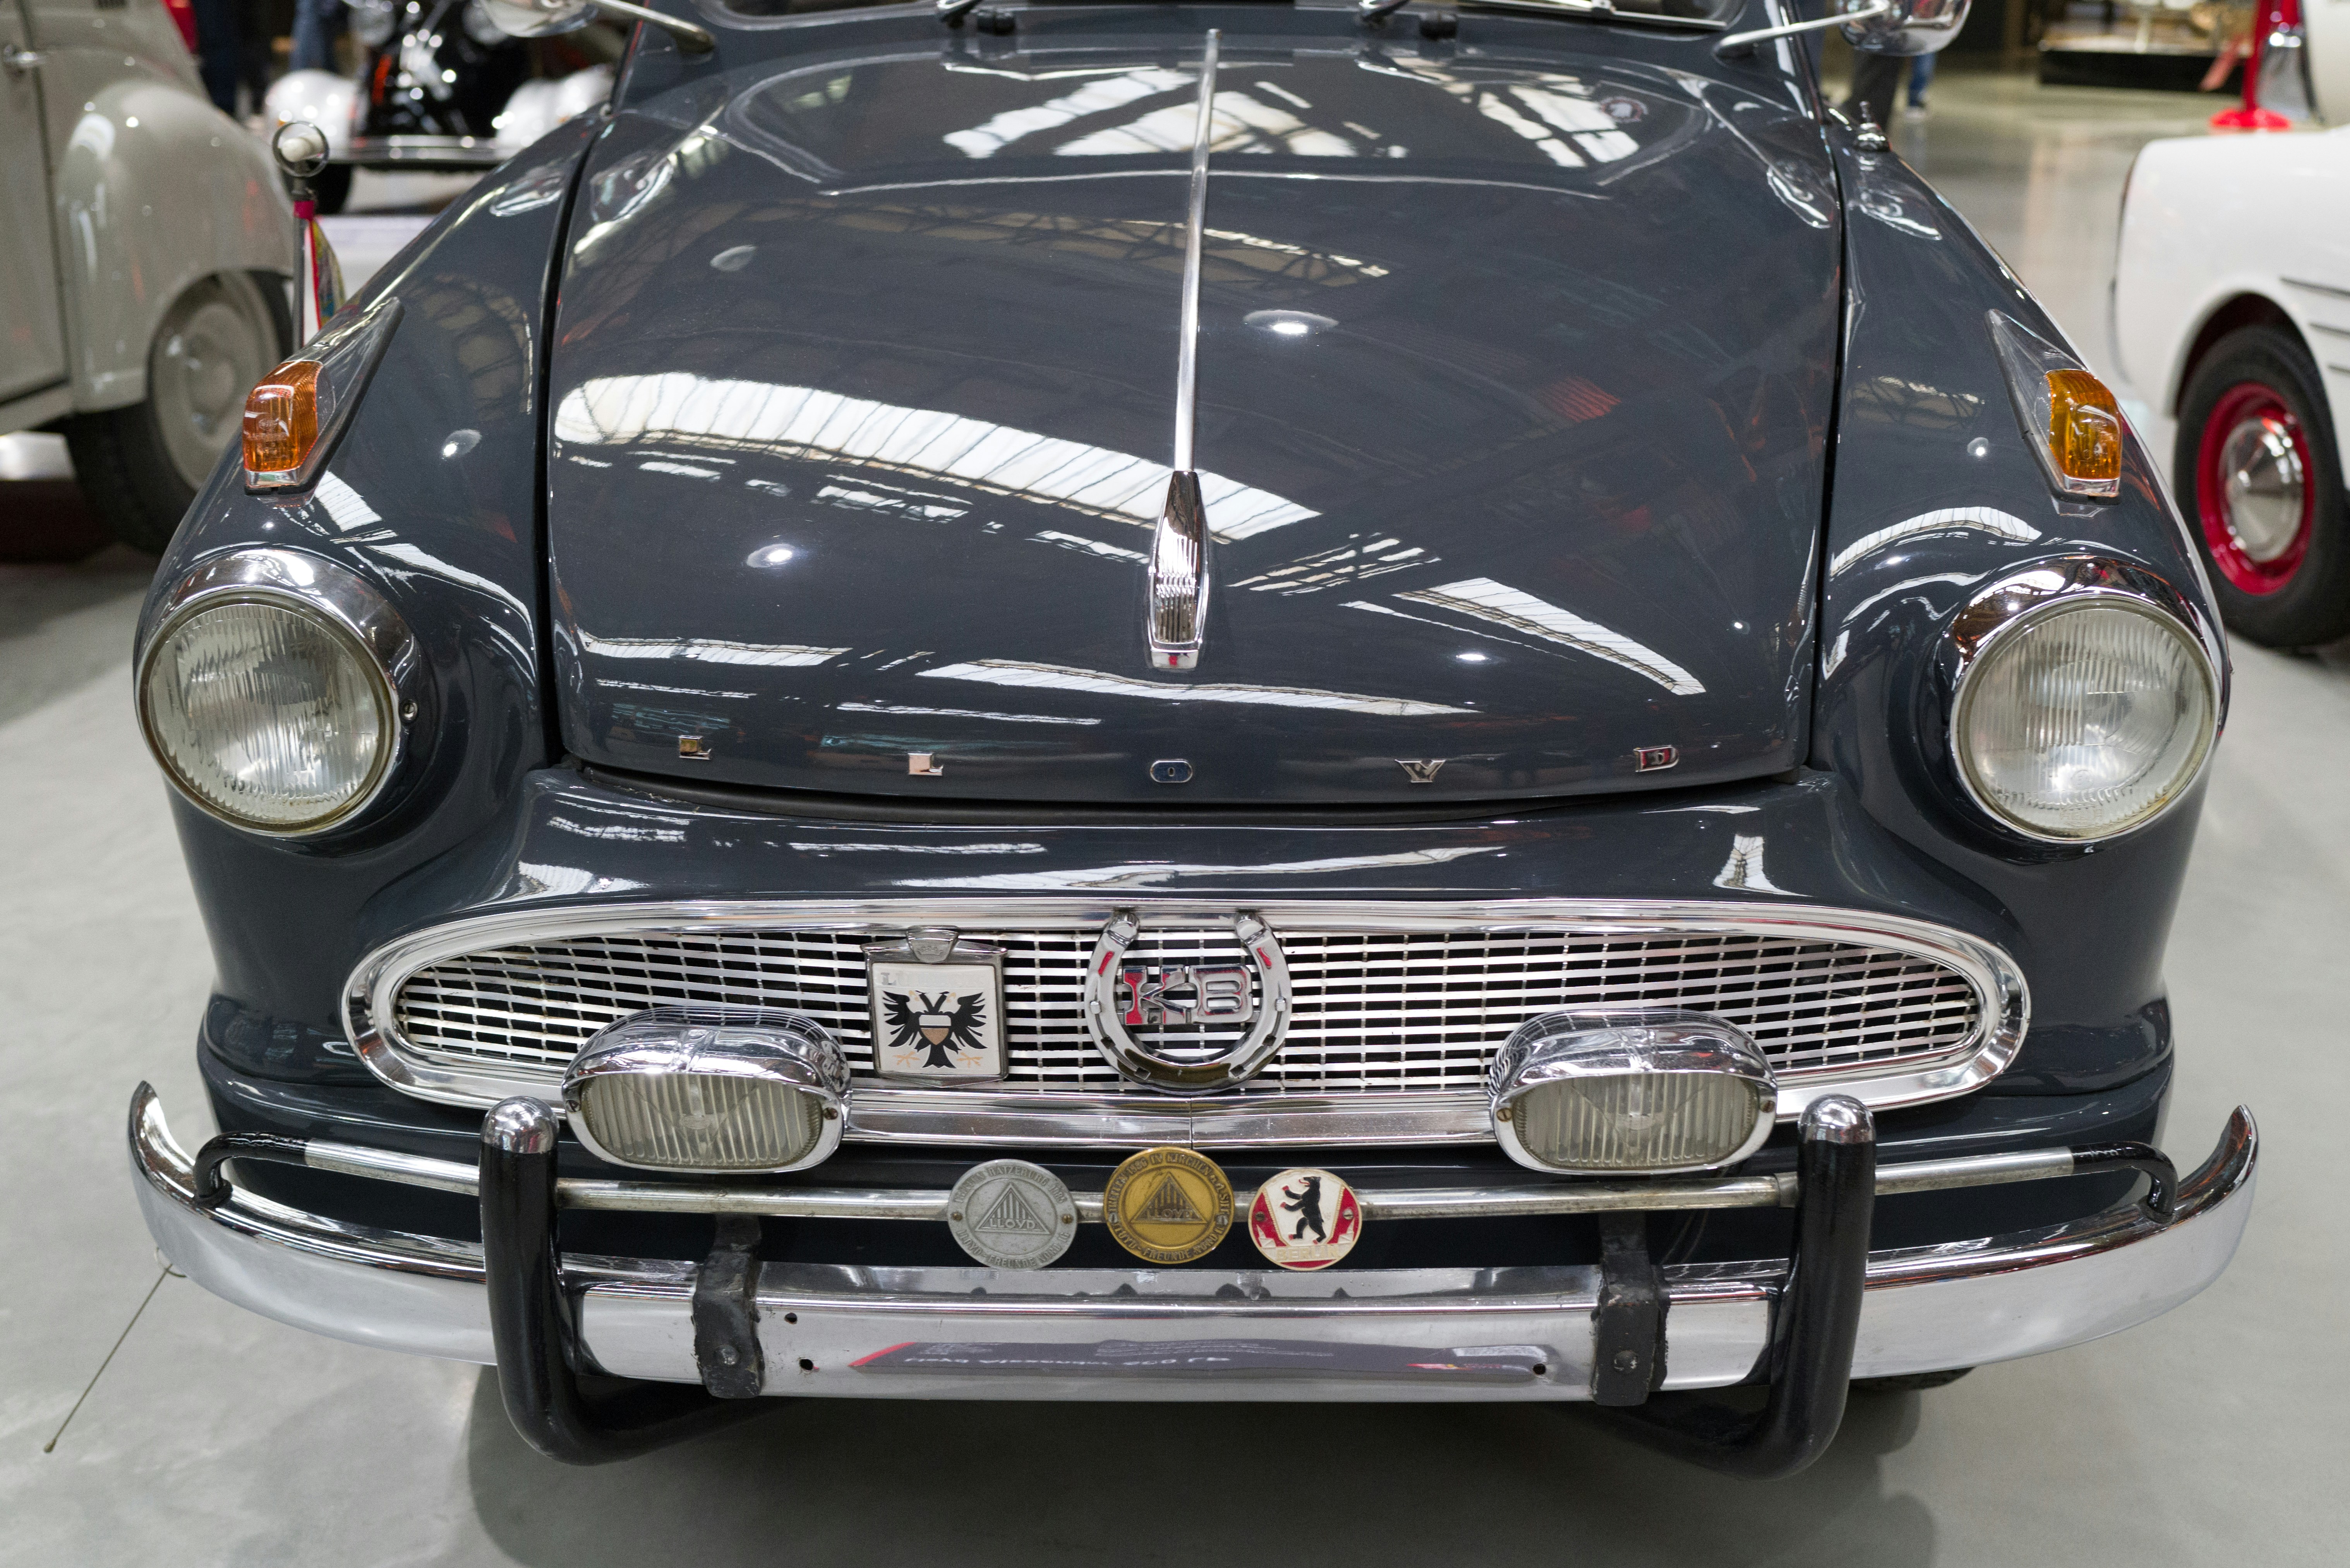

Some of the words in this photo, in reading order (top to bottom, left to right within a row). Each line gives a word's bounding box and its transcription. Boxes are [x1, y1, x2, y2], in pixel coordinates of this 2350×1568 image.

[1124, 964, 1252, 1025] KB
[1150, 1153, 1162, 1163] IN
[1146, 1208, 1193, 1219] LLOYD
[990, 1218, 1036, 1229] LLOYD
[1038, 1243, 1062, 1266] NORD
[1277, 1245, 1339, 1260] BERLIN
